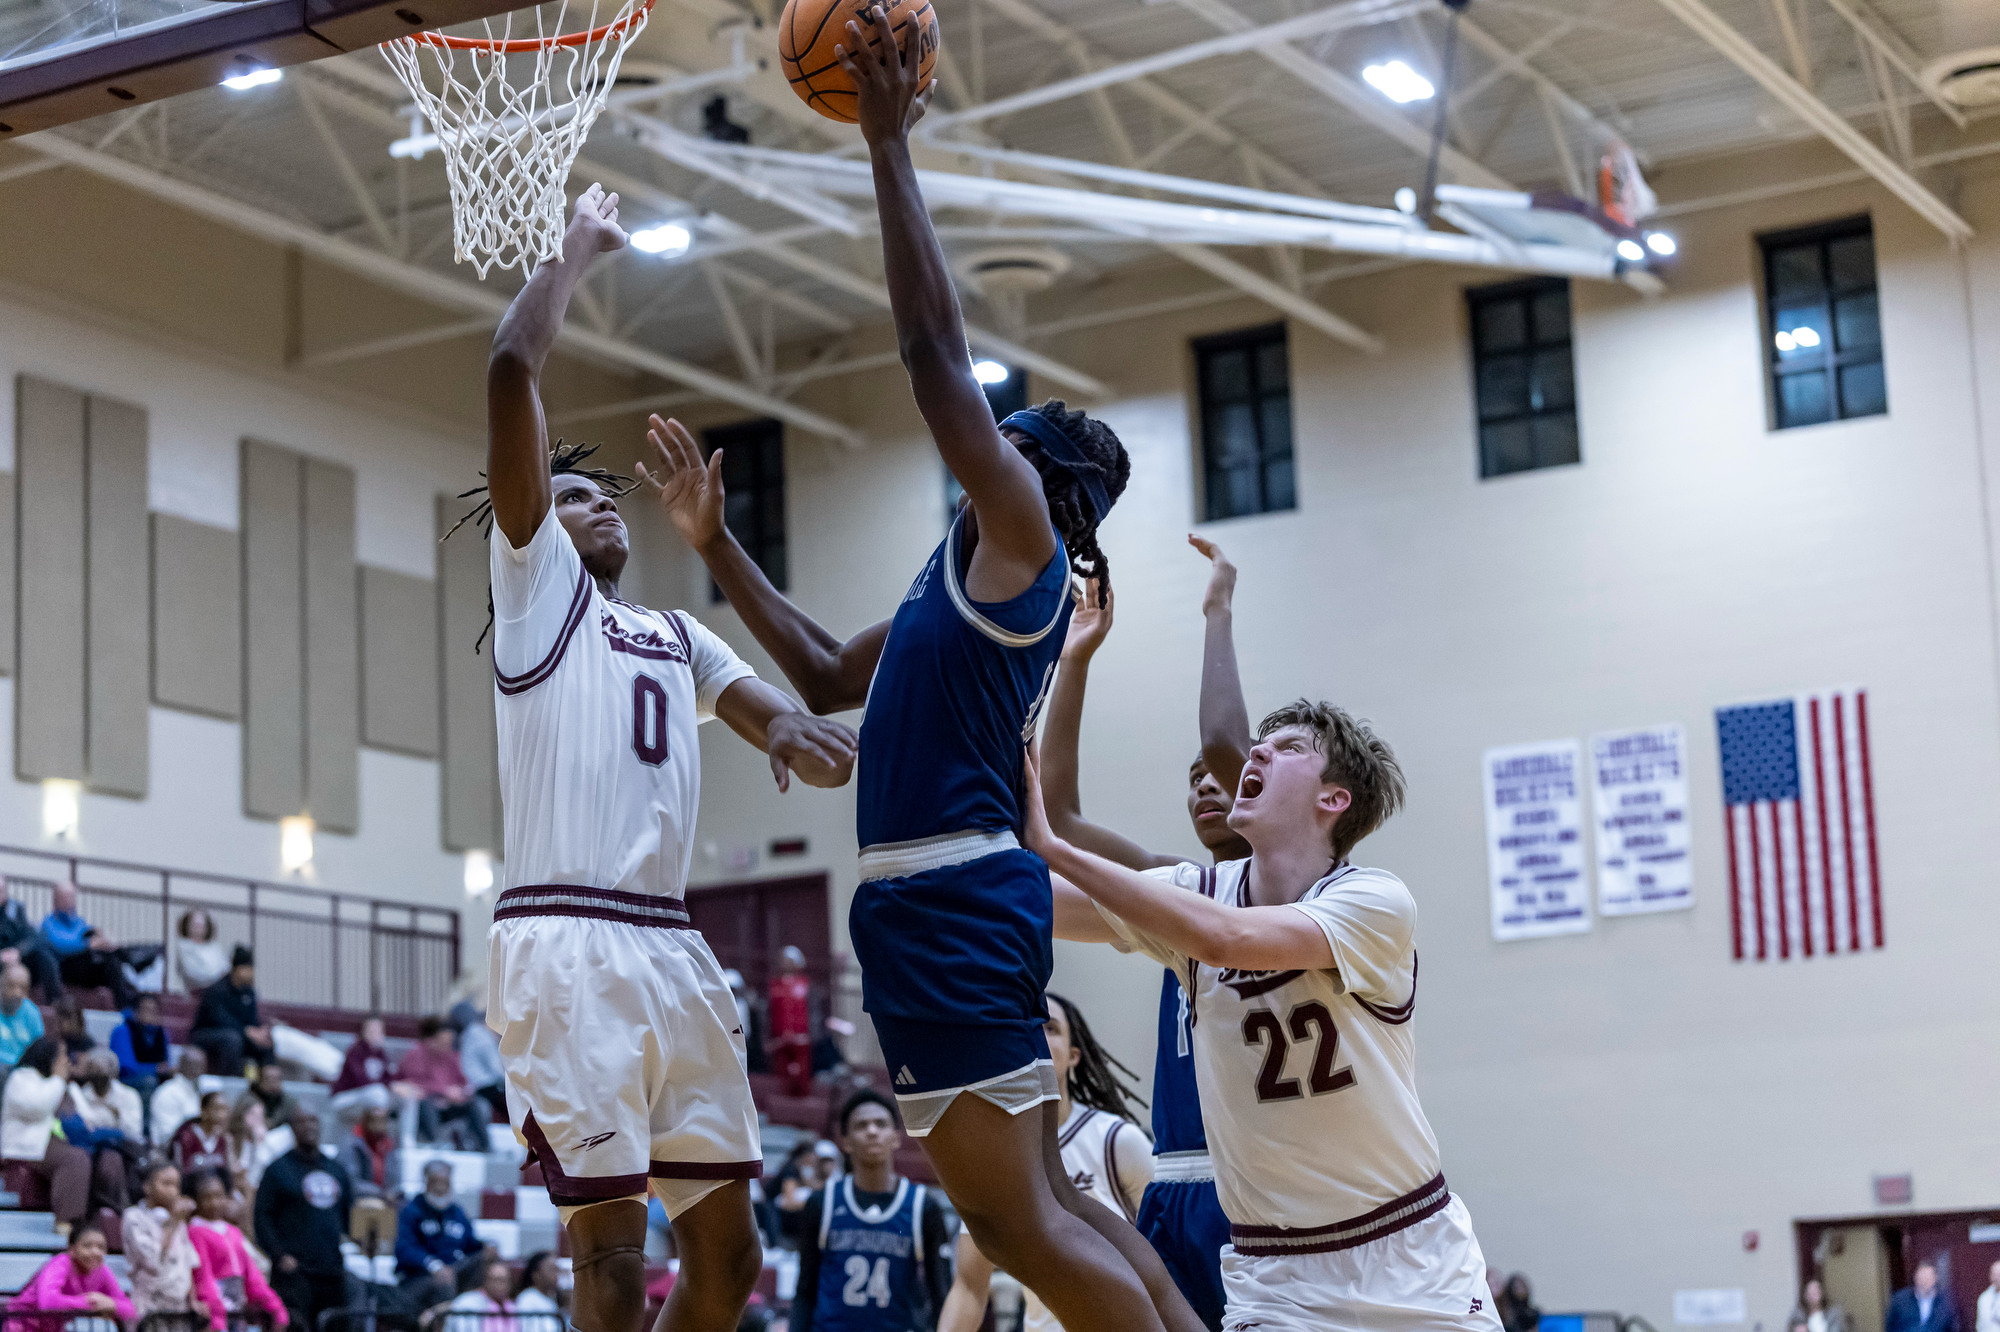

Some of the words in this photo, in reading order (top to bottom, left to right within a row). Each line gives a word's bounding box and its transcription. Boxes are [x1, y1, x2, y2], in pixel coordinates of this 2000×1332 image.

[631, 671, 670, 769] 0
[1241, 998, 1358, 1104] 22
[843, 1254, 892, 1308] 24
